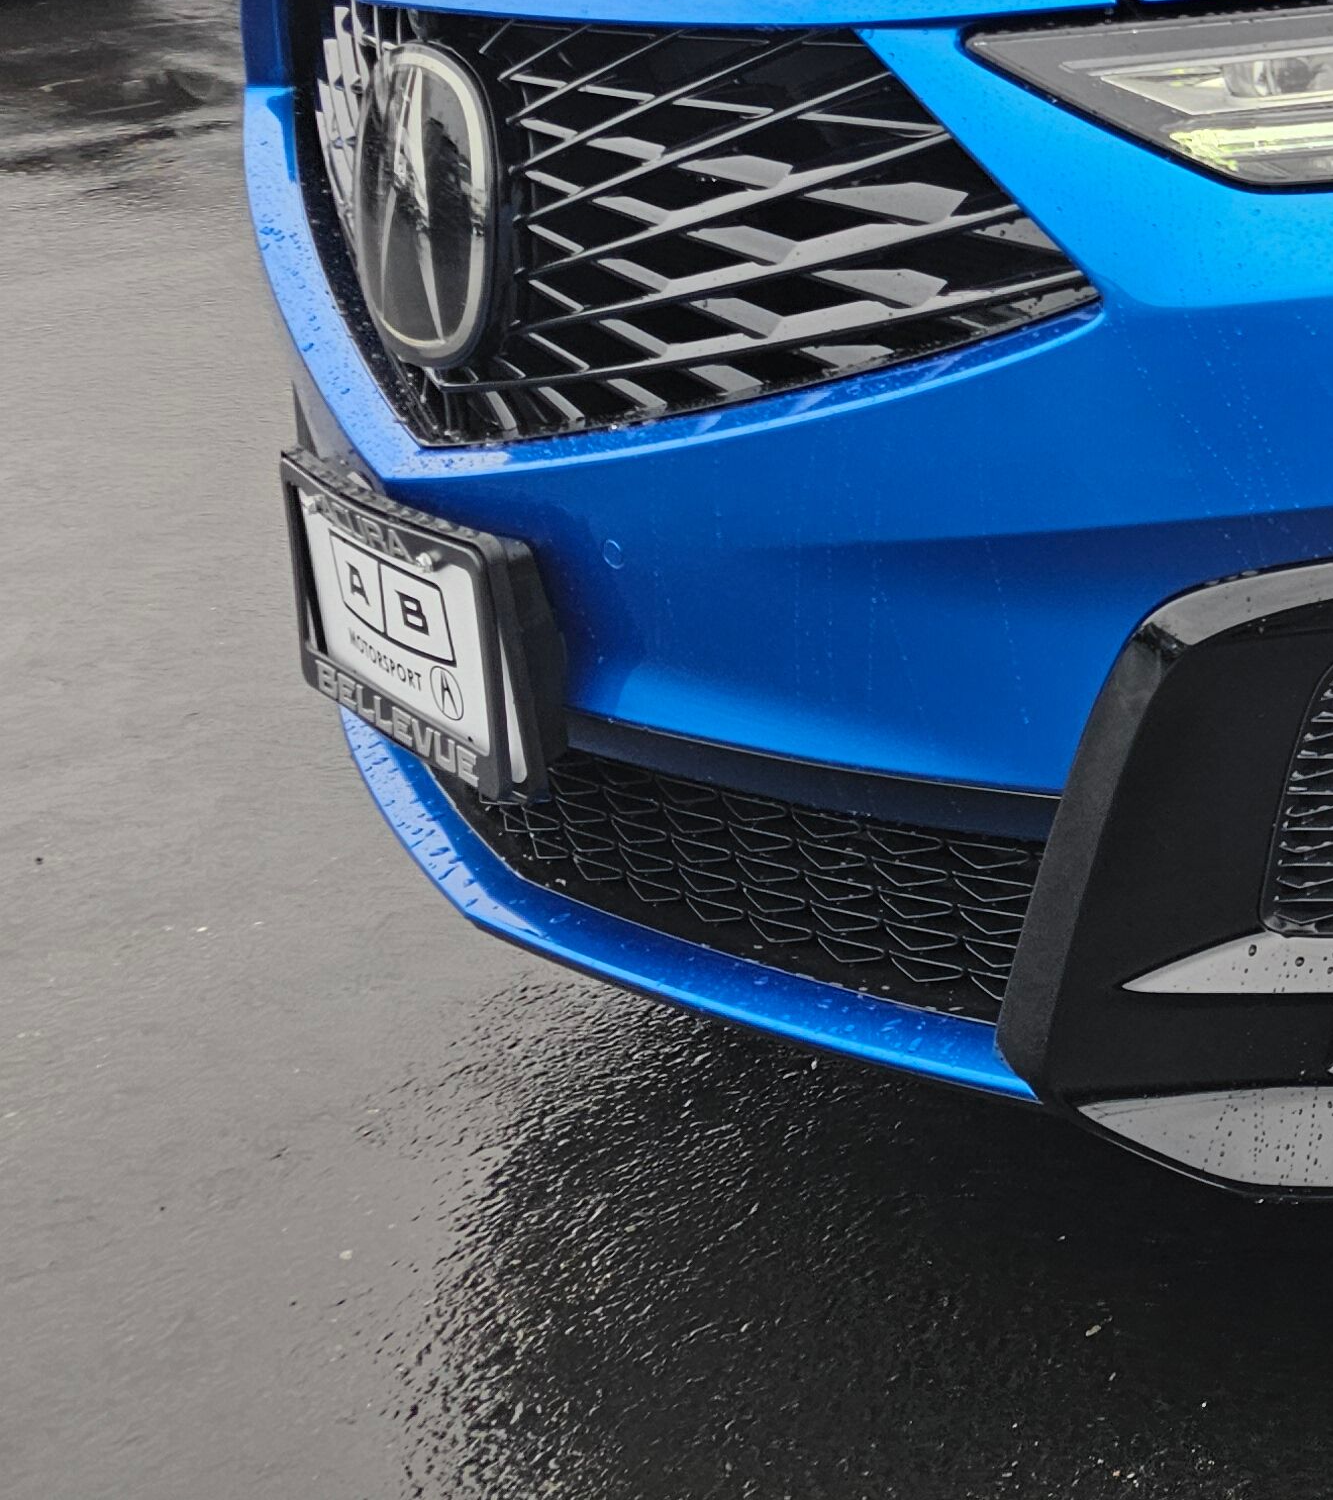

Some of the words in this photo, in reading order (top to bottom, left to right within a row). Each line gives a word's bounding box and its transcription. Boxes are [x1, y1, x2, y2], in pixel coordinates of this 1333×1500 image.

[346, 561, 371, 606] A
[394, 589, 430, 636] B
[347, 627, 422, 691] MOTORSPORT
[315, 658, 480, 788] BELLEVUE
